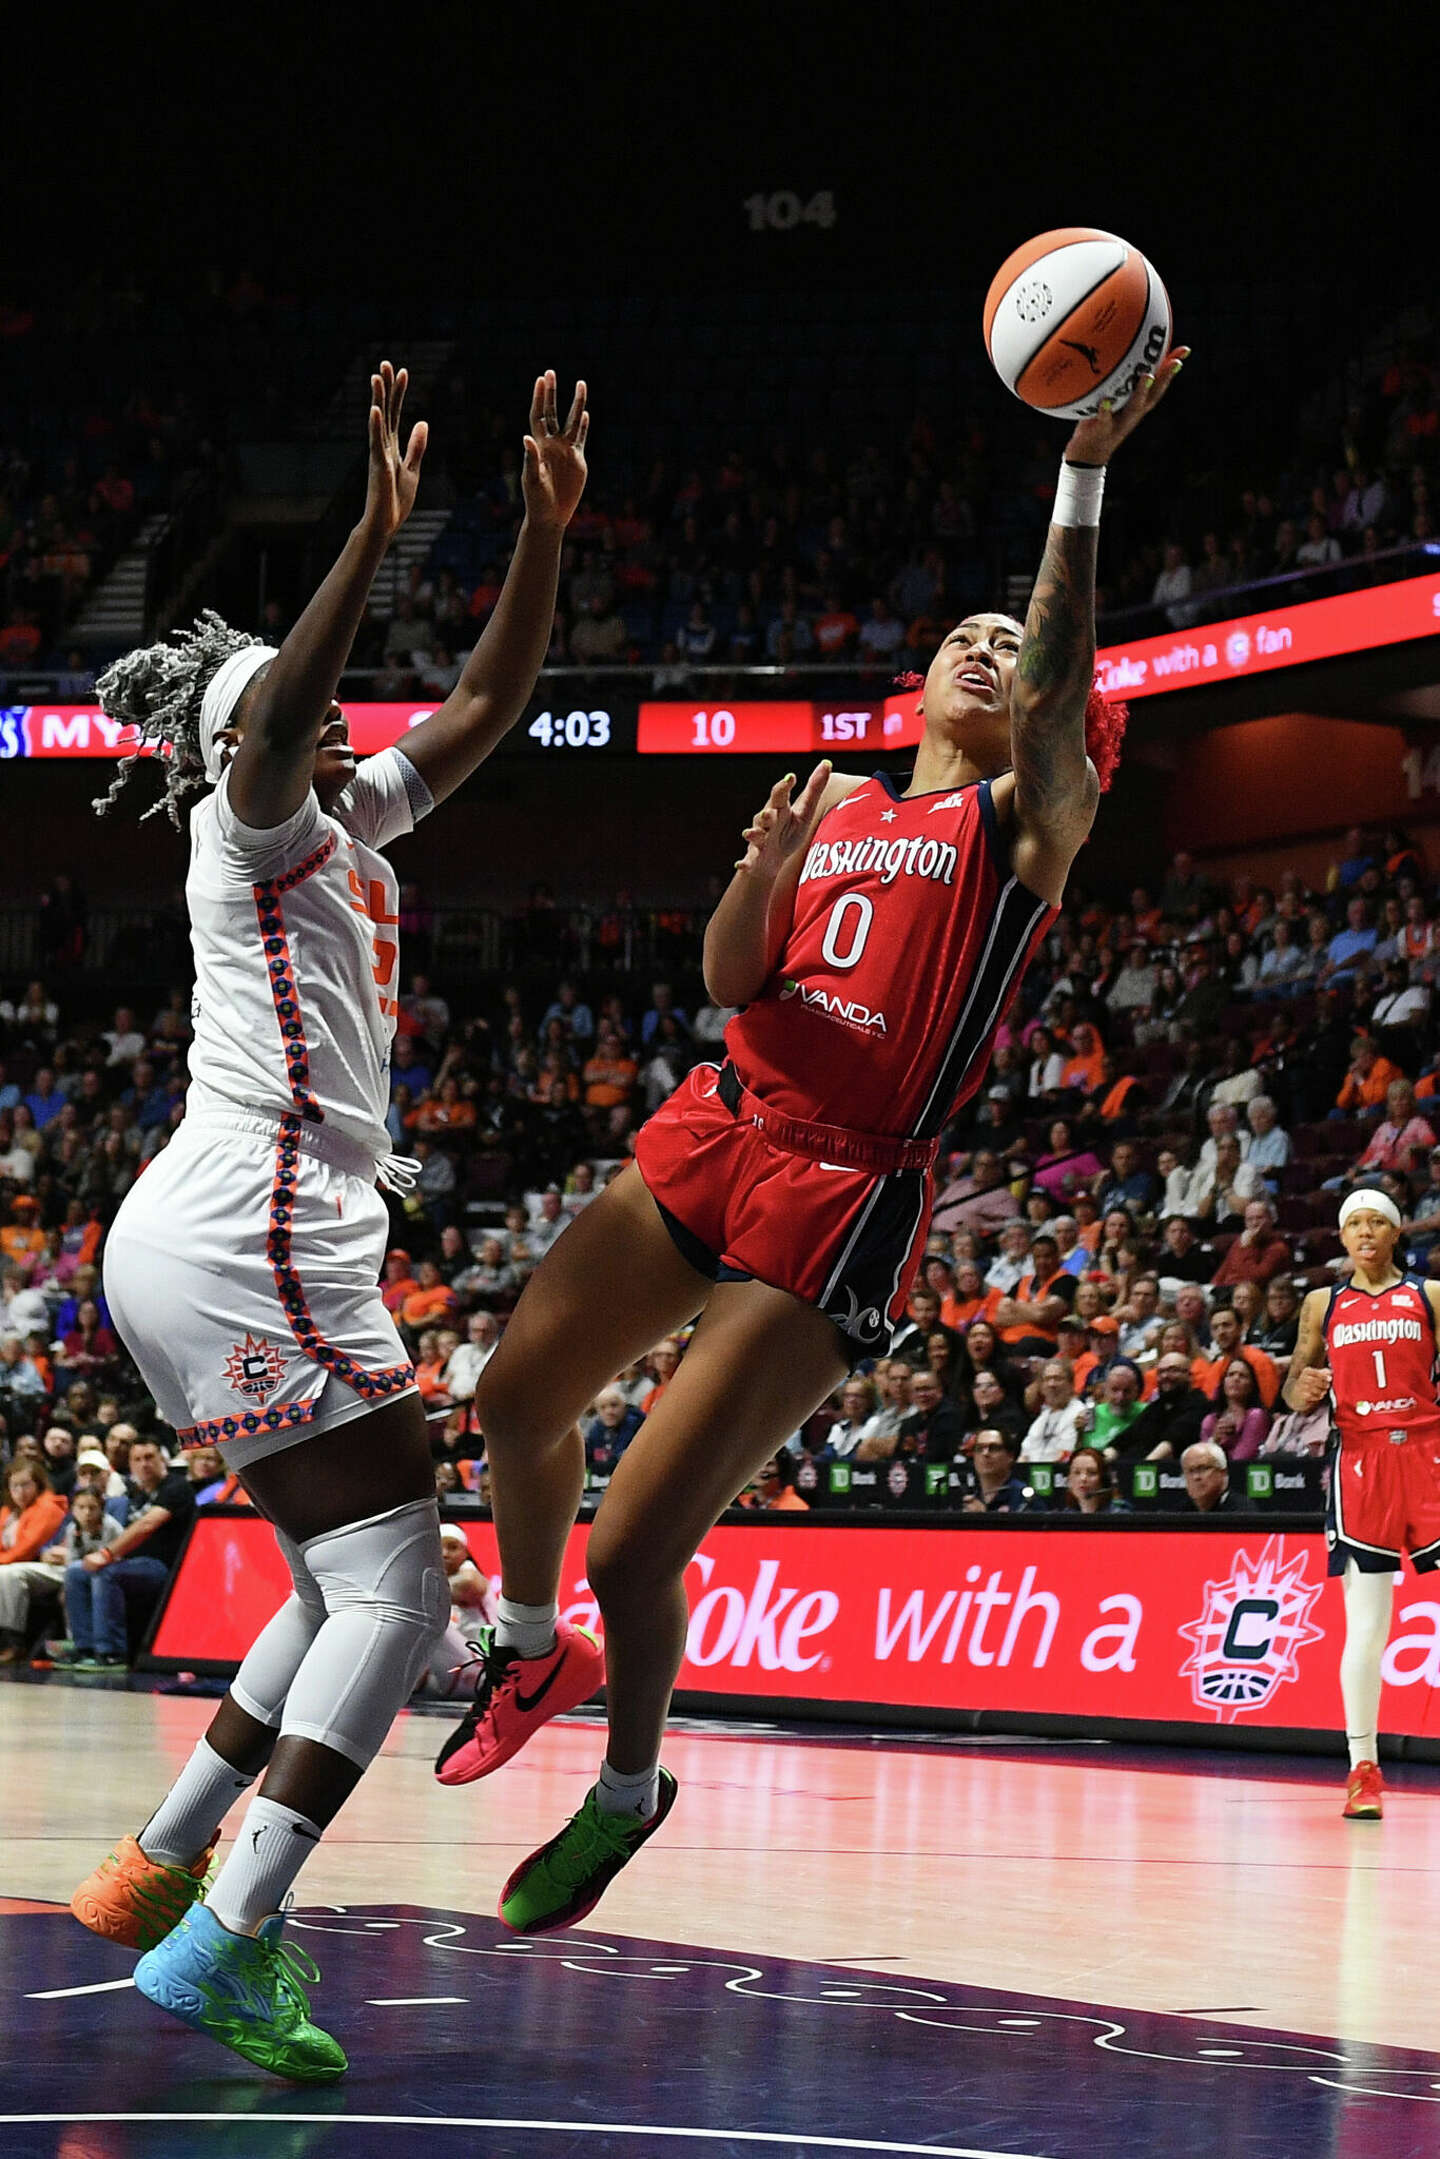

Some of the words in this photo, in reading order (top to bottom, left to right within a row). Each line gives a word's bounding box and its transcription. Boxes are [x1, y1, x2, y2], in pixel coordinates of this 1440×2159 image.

[743, 192, 836, 230] 104
[1153, 645, 1199, 677] with
[1203, 644, 1217, 667] a
[1256, 626, 1292, 654] fan
[528, 710, 611, 747] 4:03
[691, 710, 736, 746] 10
[820, 713, 872, 741] 1ST
[820, 891, 874, 969] 0
[801, 984, 888, 1033] VANDA
[1333, 1318, 1422, 1349] Washington
[242, 1355, 268, 1380] C
[1371, 1350, 1387, 1388] 1
[1135, 1470, 1156, 1491] TD
[1249, 1470, 1270, 1492] TD
[1275, 1473, 1305, 1489] Bank
[874, 1564, 1060, 1669] with
[1080, 1593, 1143, 1673] a
[1223, 1599, 1279, 1660] C
